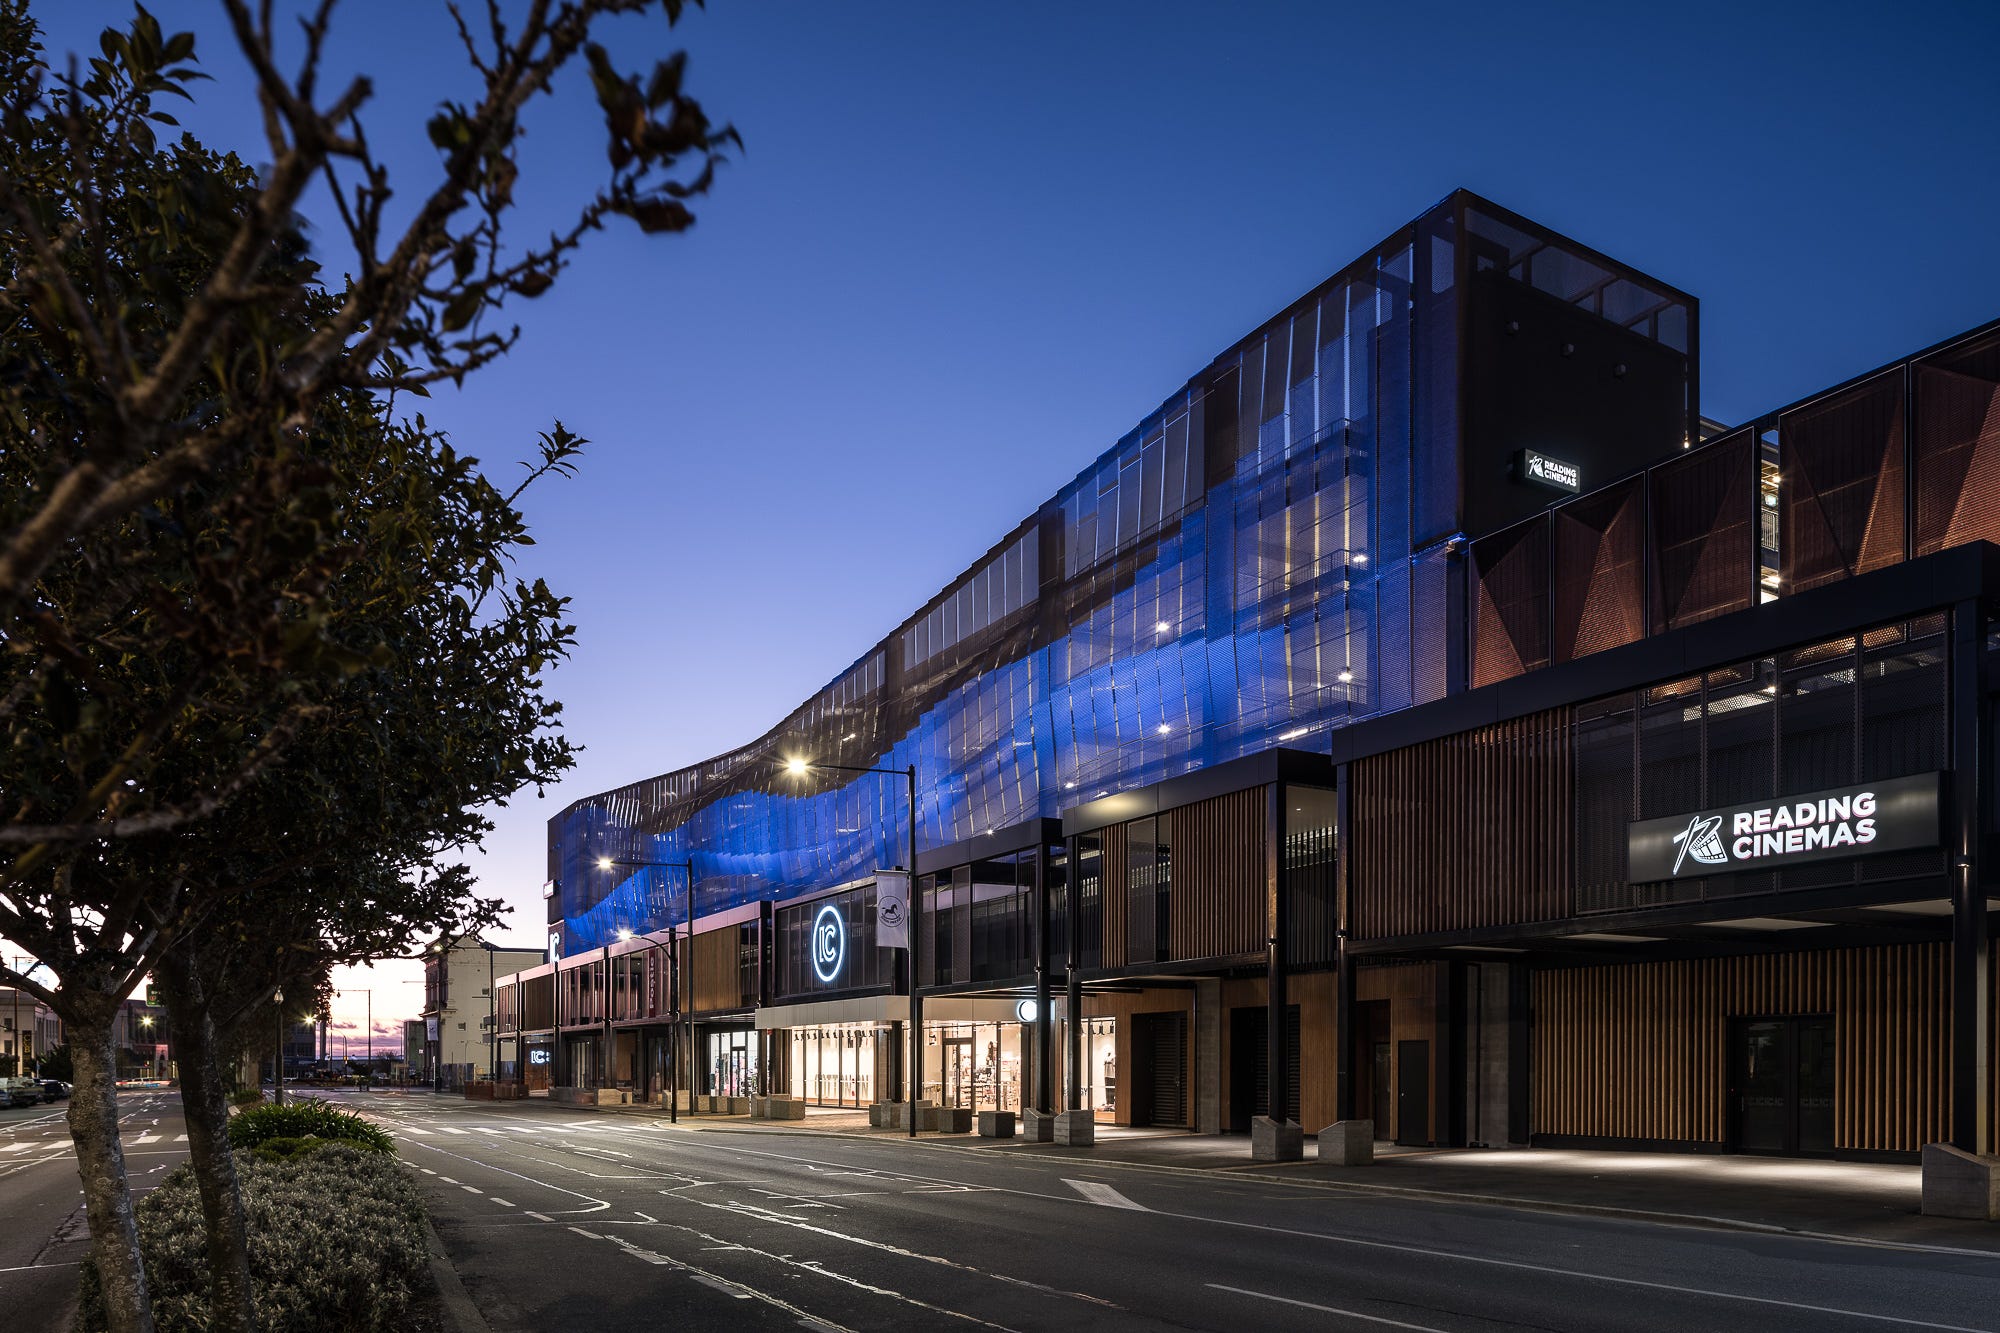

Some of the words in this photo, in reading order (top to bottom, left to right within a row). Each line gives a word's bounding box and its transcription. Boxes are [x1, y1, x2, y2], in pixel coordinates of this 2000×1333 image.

[1544, 460, 1577, 478] READING
[1544, 470, 1577, 487] CINEMAS
[1732, 792, 1877, 836] READING
[1732, 818, 1877, 861] CINEMAS
